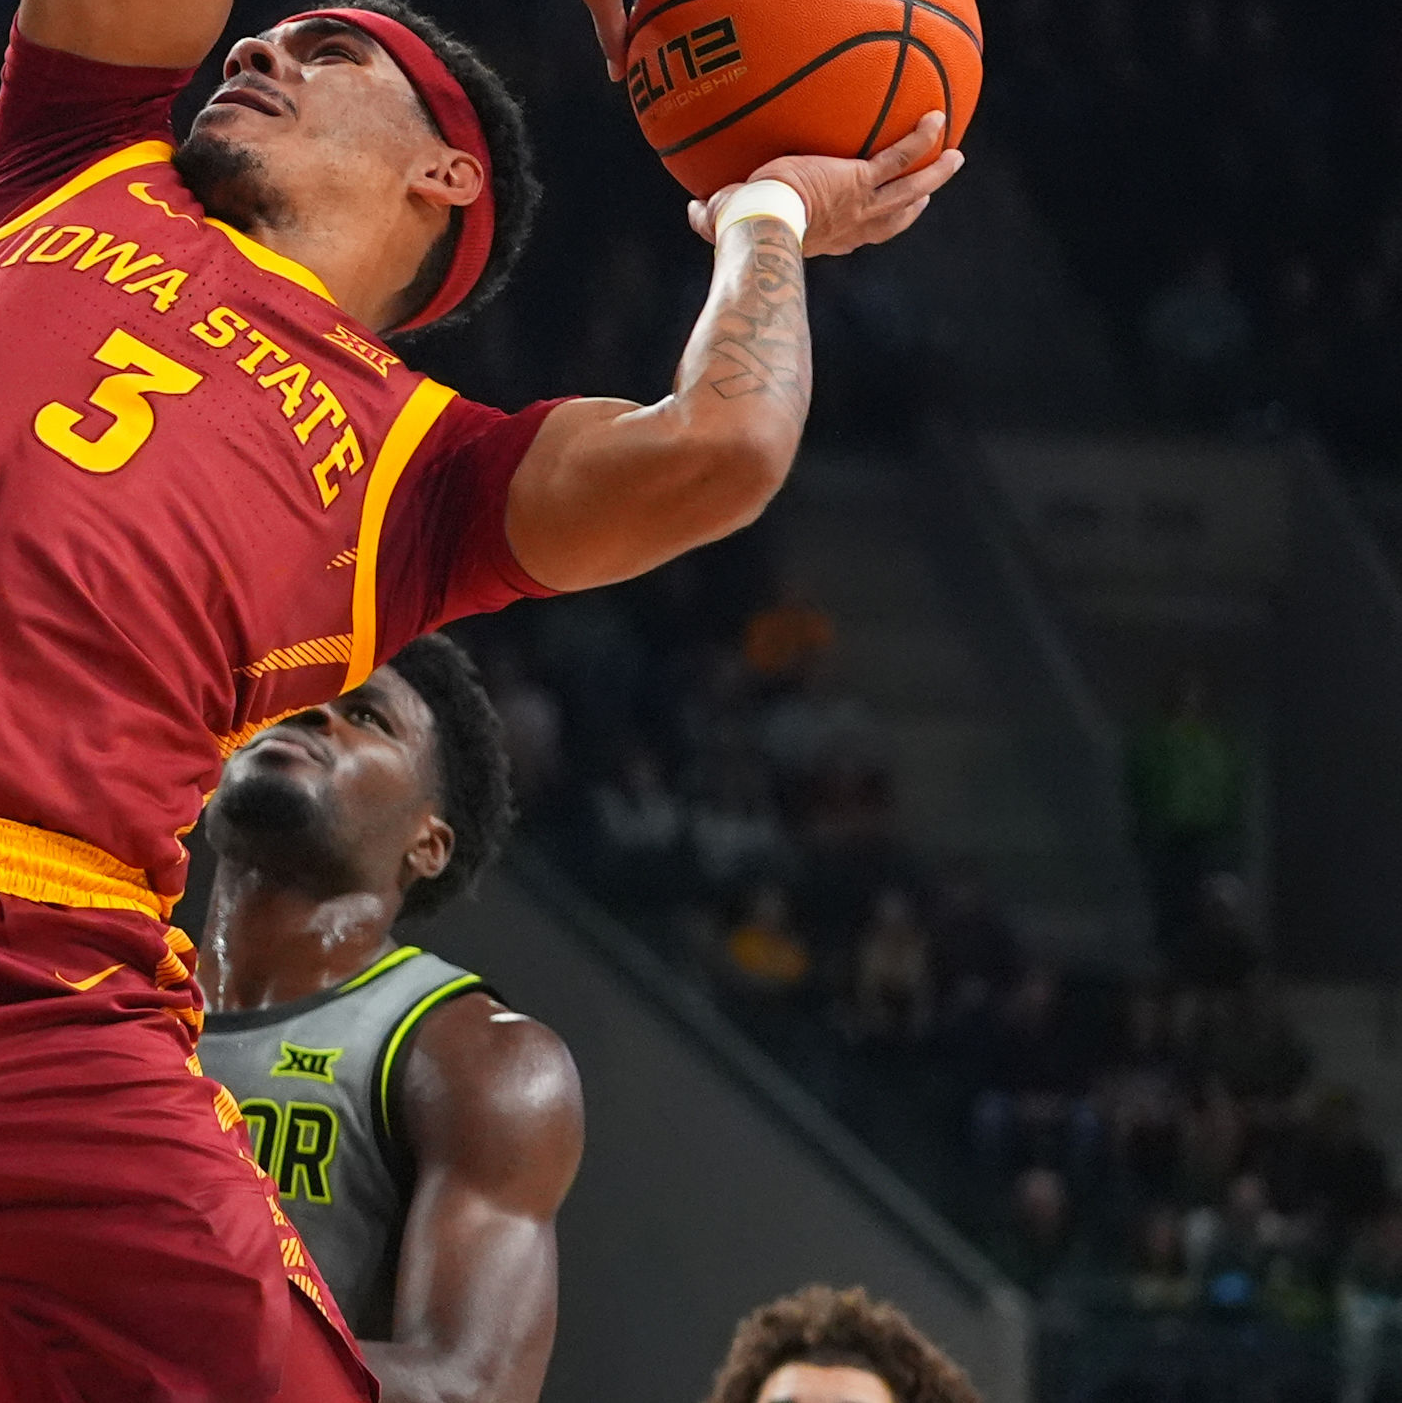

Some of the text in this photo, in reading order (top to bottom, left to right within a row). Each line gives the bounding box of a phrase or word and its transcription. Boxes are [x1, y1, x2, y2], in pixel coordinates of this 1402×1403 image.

[0, 224, 365, 510] IOWA STATE
[33, 327, 205, 475] 3
